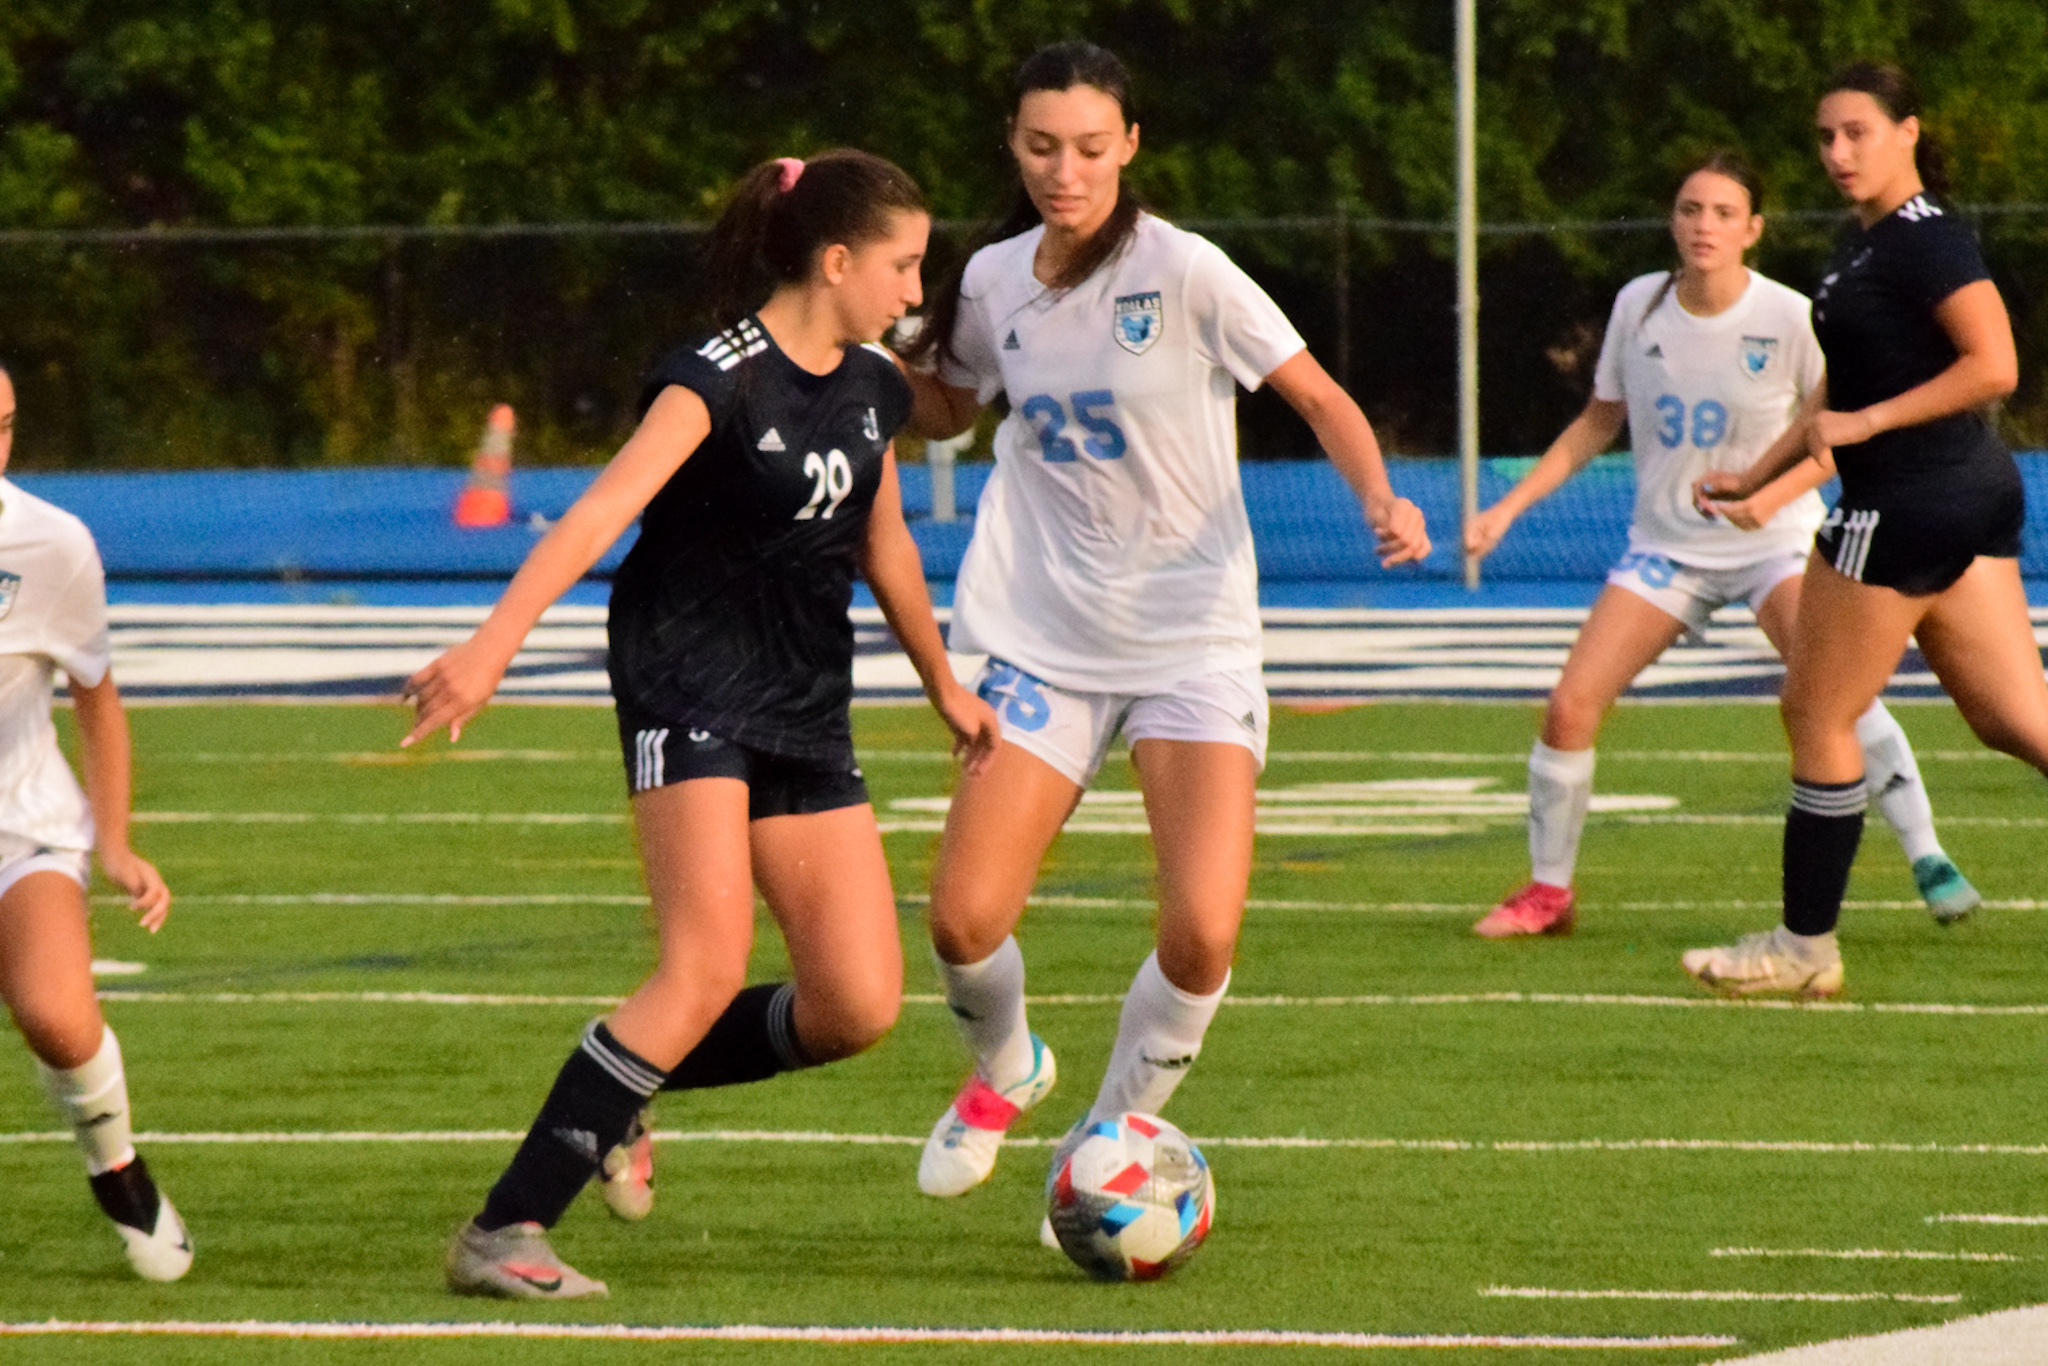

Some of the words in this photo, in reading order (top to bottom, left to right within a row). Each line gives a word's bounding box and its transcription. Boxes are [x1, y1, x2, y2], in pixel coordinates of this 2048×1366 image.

[1022, 389, 1126, 463] 25
[1655, 395, 1727, 449] 38
[793, 449, 853, 520] 29
